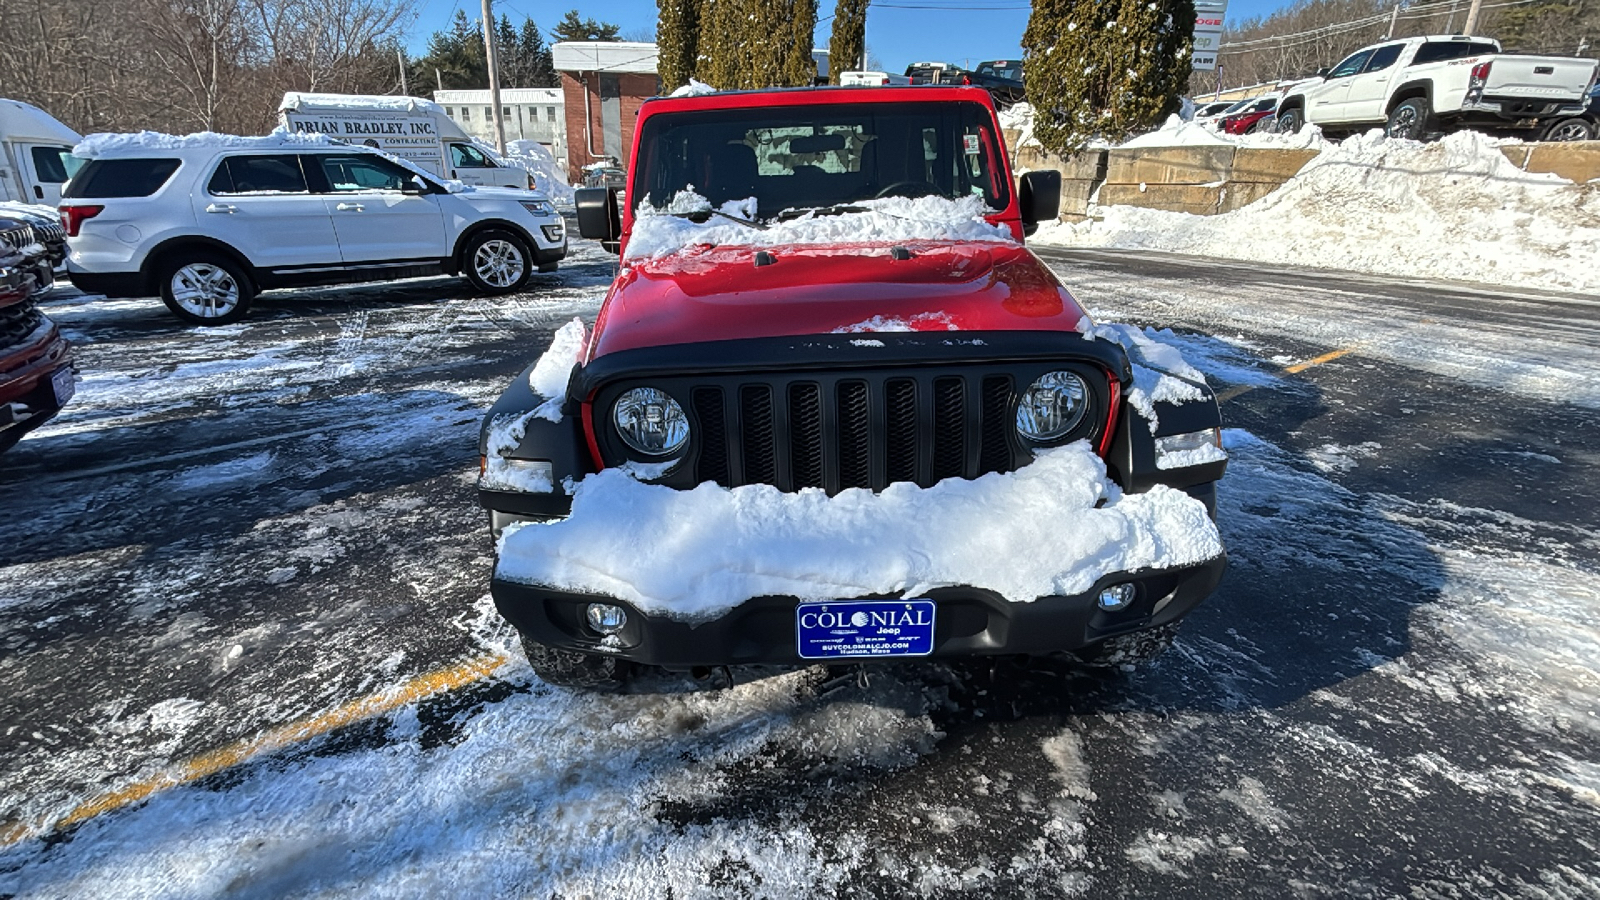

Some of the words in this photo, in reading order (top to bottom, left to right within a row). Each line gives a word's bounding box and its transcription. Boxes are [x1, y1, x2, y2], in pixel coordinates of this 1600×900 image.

[1195, 18, 1222, 26] DGE
[1196, 38, 1212, 48] ep
[294, 121, 339, 134] BRIAN
[343, 122, 408, 136] BRADLEY,
[410, 122, 436, 135] INC.
[801, 610, 931, 629] COLONIAL
[876, 626, 901, 636] Jeep
[822, 642, 910, 651] BUYCOLONIALCJD.COM
